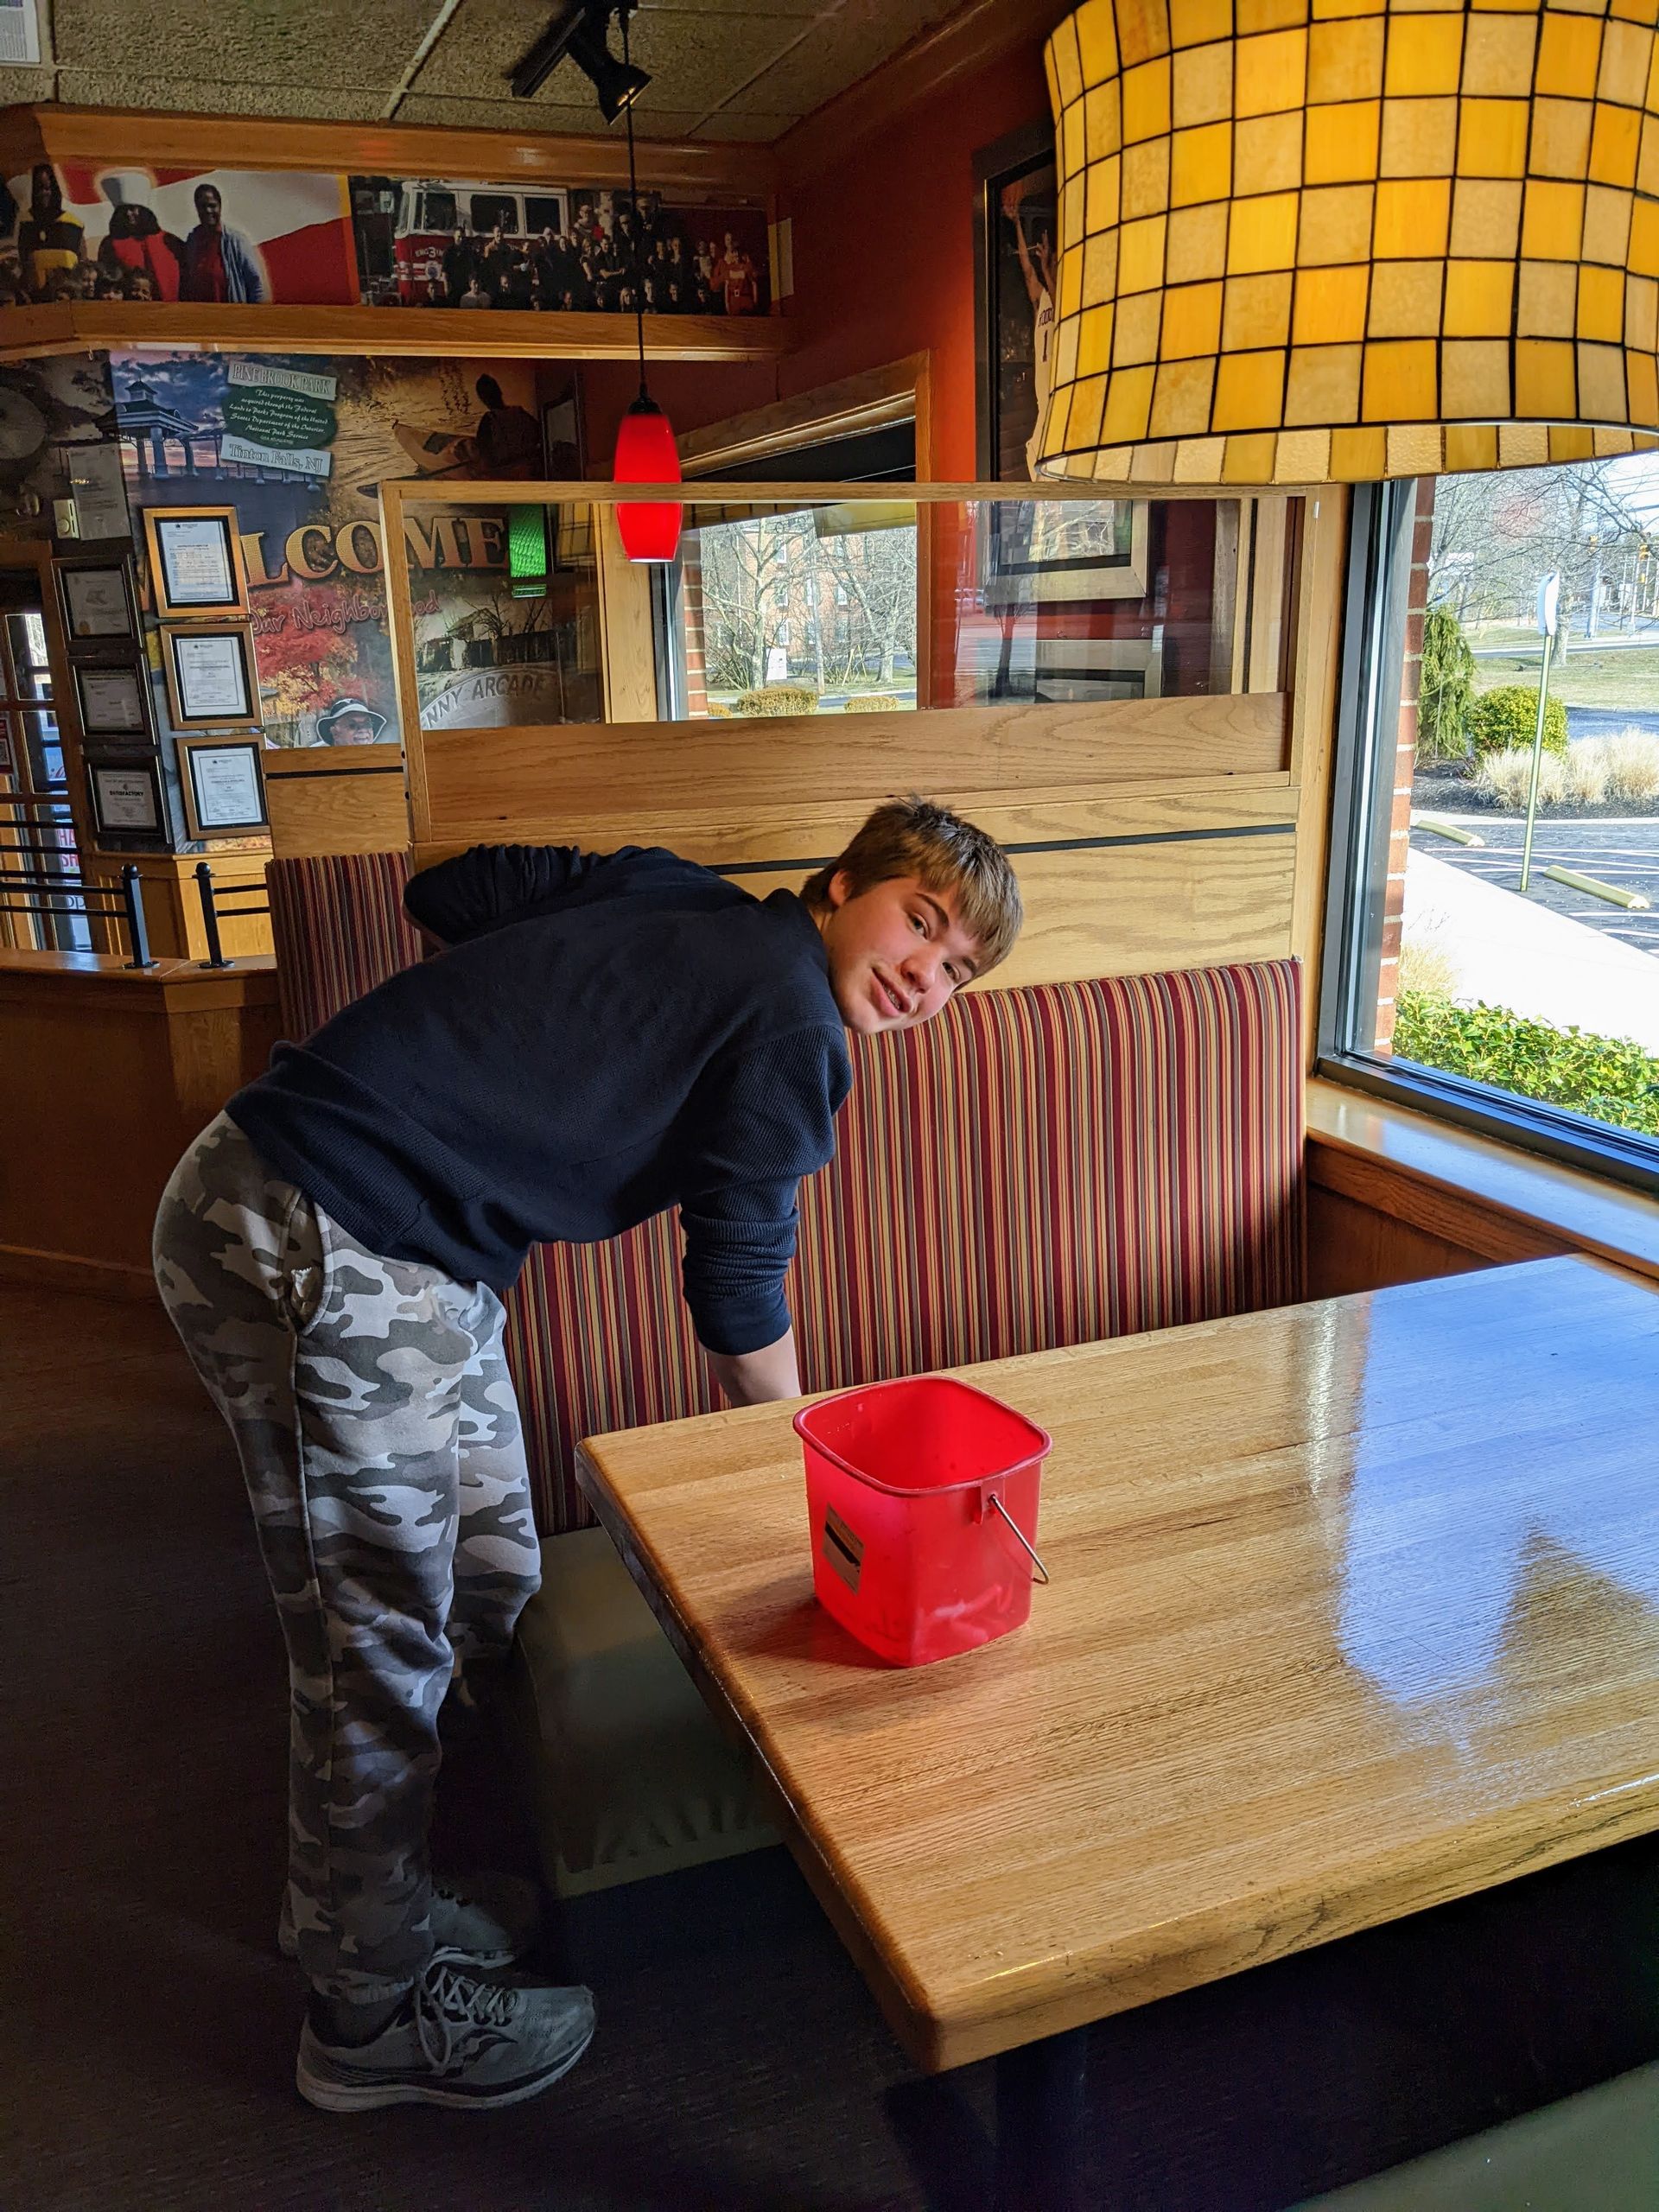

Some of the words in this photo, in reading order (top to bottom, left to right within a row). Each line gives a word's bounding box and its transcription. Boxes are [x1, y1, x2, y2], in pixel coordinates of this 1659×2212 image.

[233, 364, 259, 384] PINE
[260, 369, 299, 390] BROOK
[300, 376, 331, 395] PARK
[270, 394, 294, 404] property
[251, 406, 269, 415] Parks
[269, 410, 294, 419] Program
[264, 401, 284, 410] through
[294, 404, 317, 414] Federal
[230, 413, 251, 422] States
[251, 416, 283, 425] Department
[245, 424, 270, 434] National
[286, 430, 308, 440] Service
[229, 442, 270, 463] Tinton
[270, 449, 304, 471] Falls,
[305, 455, 324, 474] NJ
[292, 588, 443, 635] Neighborod
